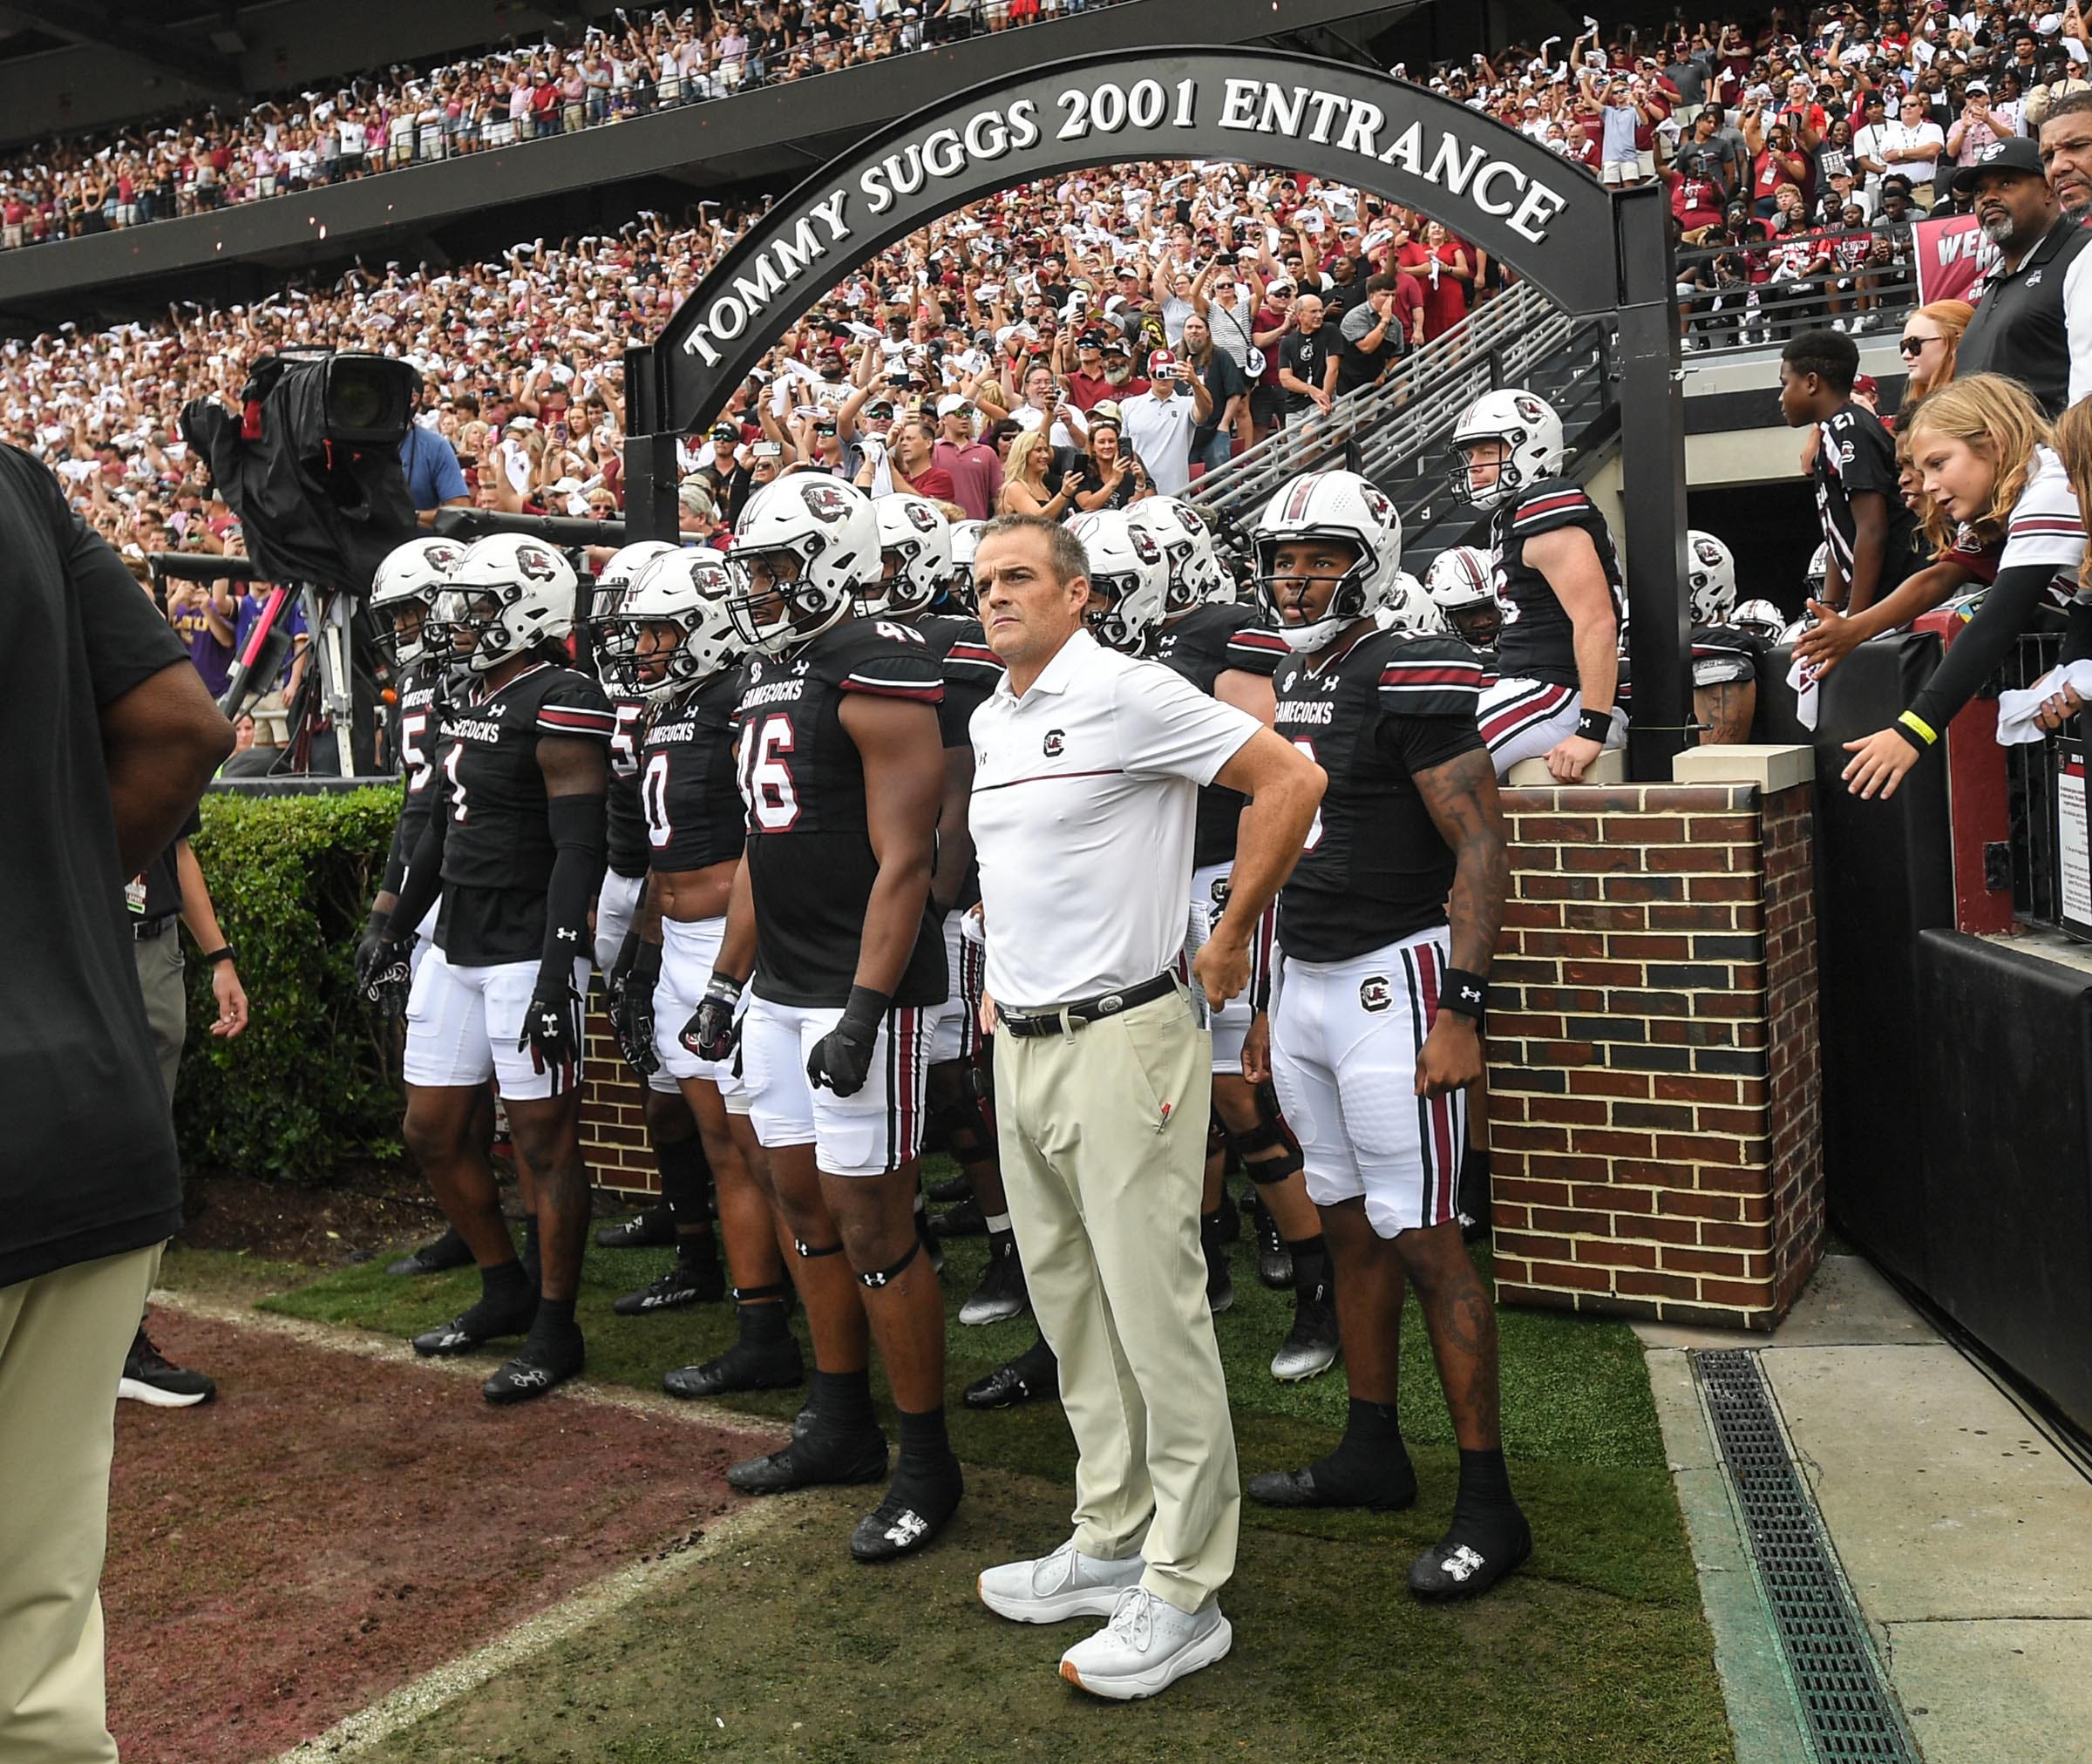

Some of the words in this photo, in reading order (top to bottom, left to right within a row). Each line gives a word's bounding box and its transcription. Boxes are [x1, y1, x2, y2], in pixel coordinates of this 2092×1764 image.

[683, 189, 851, 368] TOMMY
[859, 98, 1038, 214] SUGGS
[1056, 78, 1197, 140] 2001
[1218, 78, 1570, 245] ENTRANCE
[1832, 411, 1856, 431] 21
[443, 742, 468, 822] 1
[642, 751, 672, 849] 0
